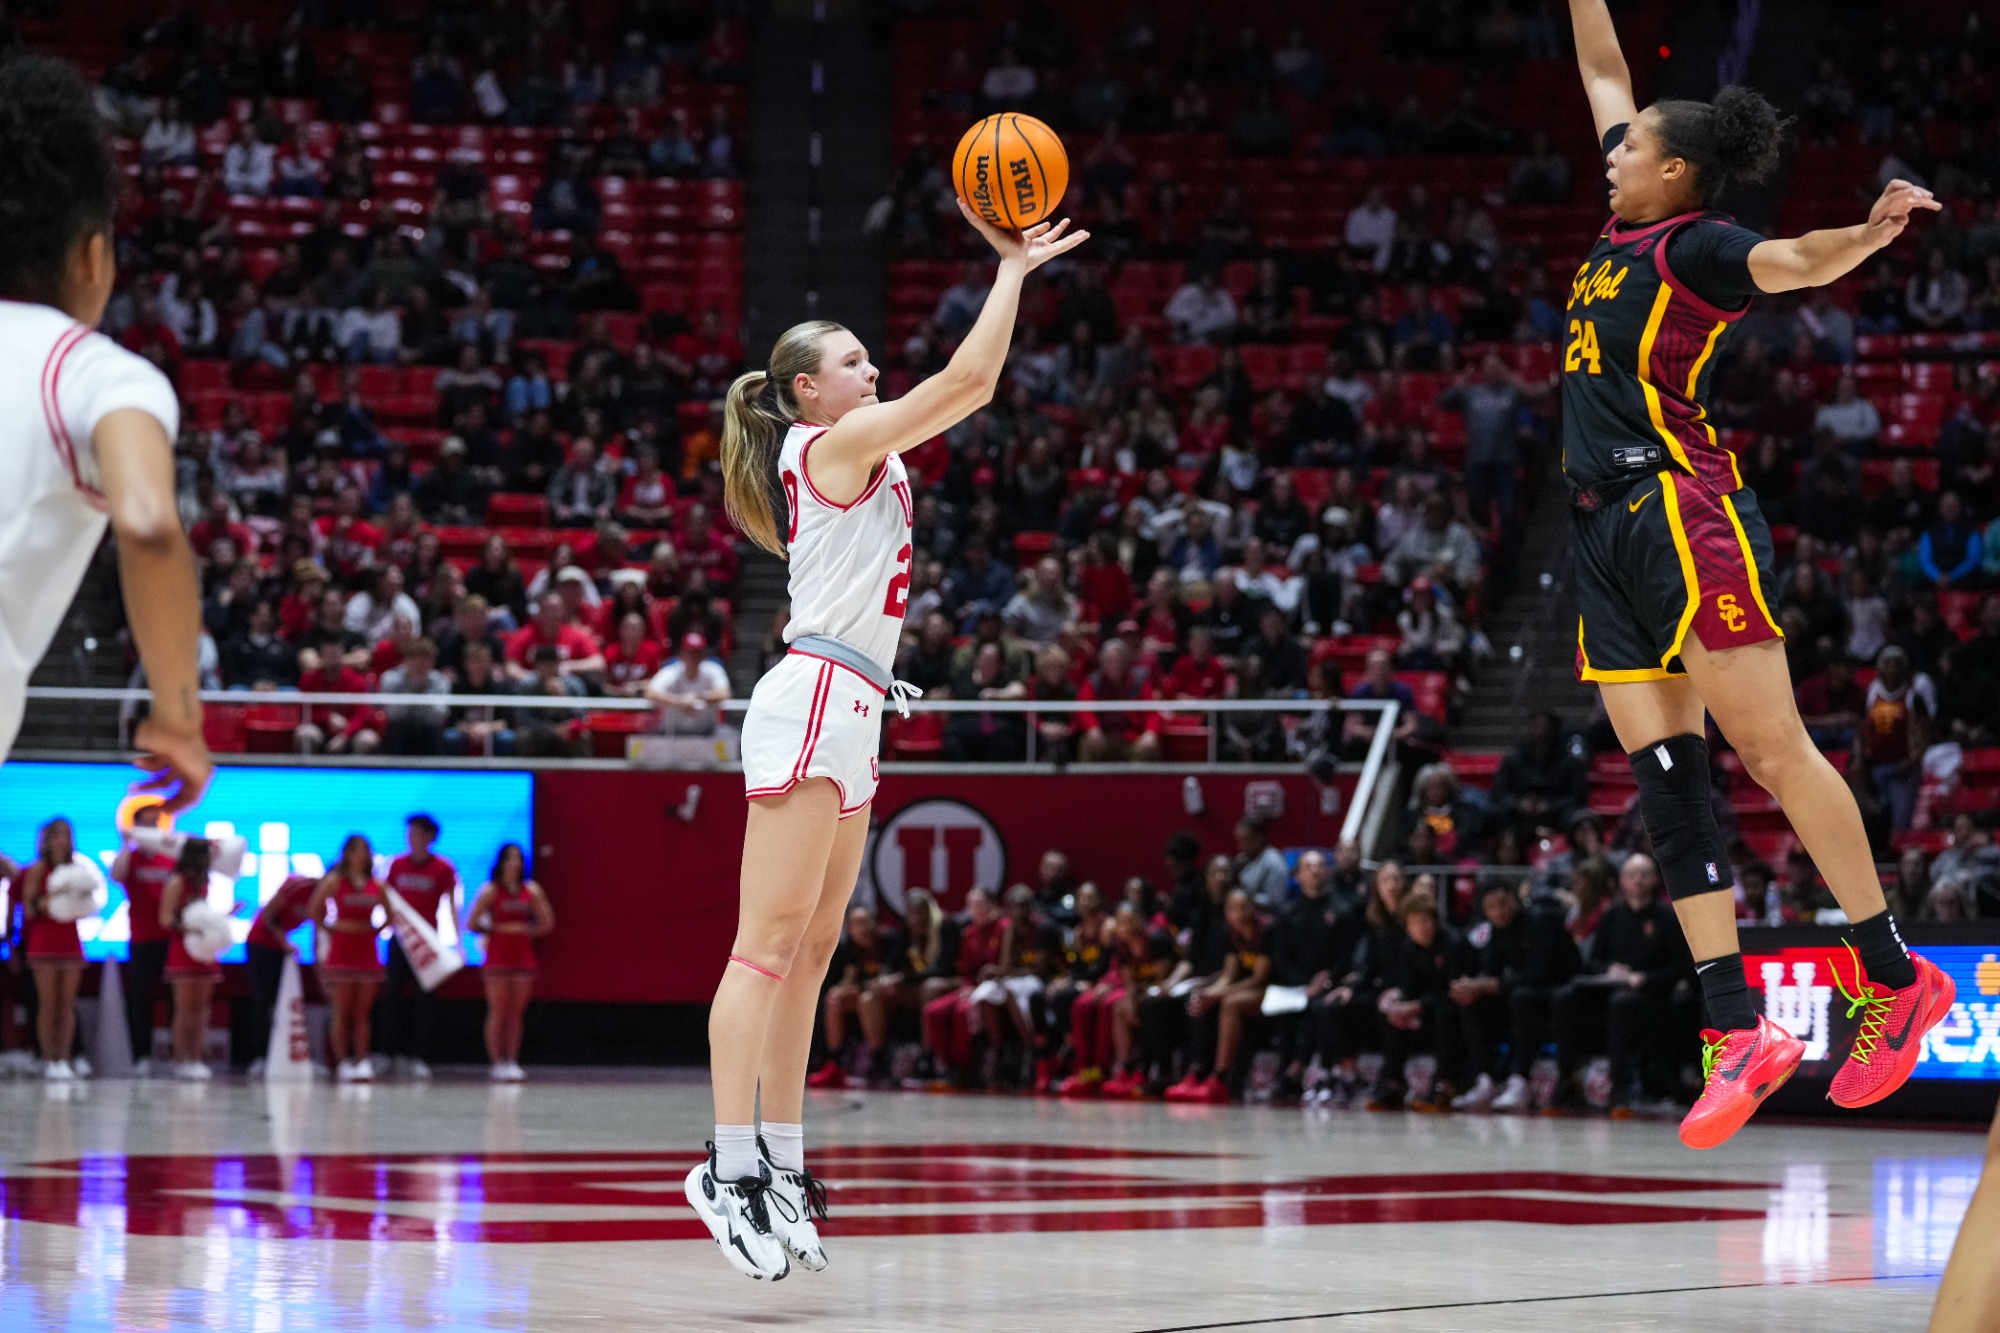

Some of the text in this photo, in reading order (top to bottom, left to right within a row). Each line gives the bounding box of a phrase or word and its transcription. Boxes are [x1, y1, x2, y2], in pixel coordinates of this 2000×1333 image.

[974, 155, 1001, 222] Wilson
[1010, 157, 1037, 215] UTAH
[1565, 319, 1601, 374] 24
[1717, 594, 1747, 632] SC
[897, 826, 983, 913] U
